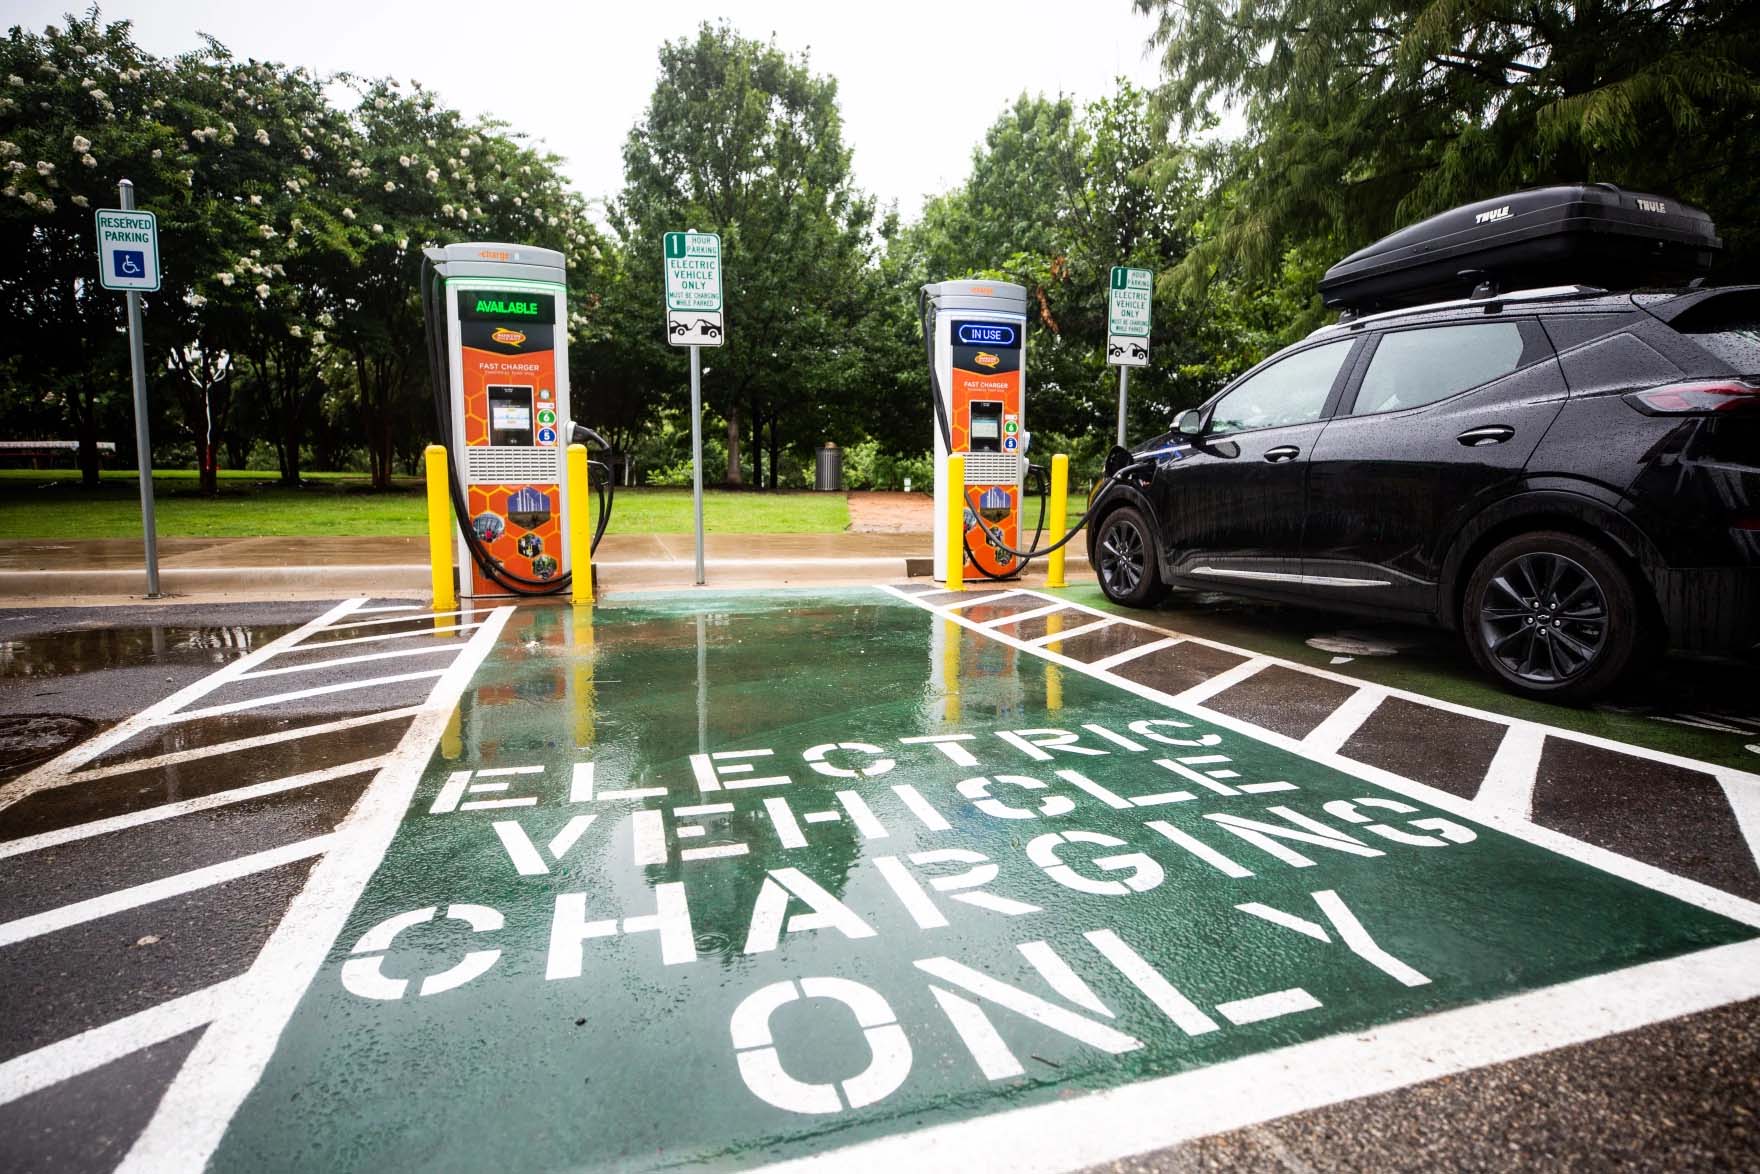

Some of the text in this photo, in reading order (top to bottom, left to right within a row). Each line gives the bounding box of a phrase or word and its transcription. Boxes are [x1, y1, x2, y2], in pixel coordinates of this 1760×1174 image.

[1636, 199, 1666, 213] THULE
[1476, 206, 1510, 223] THULE
[100, 217, 152, 230] RESERVED
[105, 231, 149, 243] PARKING
[691, 236, 711, 245] HOUR
[672, 235, 678, 254] 1
[687, 246, 717, 254] PARKING
[671, 260, 716, 270] ELECTRIC
[674, 271, 713, 280] VEHICLE
[1117, 269, 1122, 287] 1
[681, 281, 706, 290] ONLY
[1114, 291, 1148, 301] ELECTRIC
[476, 300, 538, 315] AVAILABLE
[1116, 301, 1145, 310] VEHICLE
[1121, 310, 1140, 318] ONLY
[971, 328, 1001, 340] IN USE
[479, 362, 540, 371] FAST CHARGER
[543, 413, 550, 422] 6
[543, 432, 550, 440] 5
[1008, 440, 1014, 448] 5
[429, 720, 1222, 814] ELECTRIC
[491, 754, 1301, 875] VEHICLE
[341, 797, 1478, 1000] CHARGING
[729, 888, 1433, 1115] ONLY
